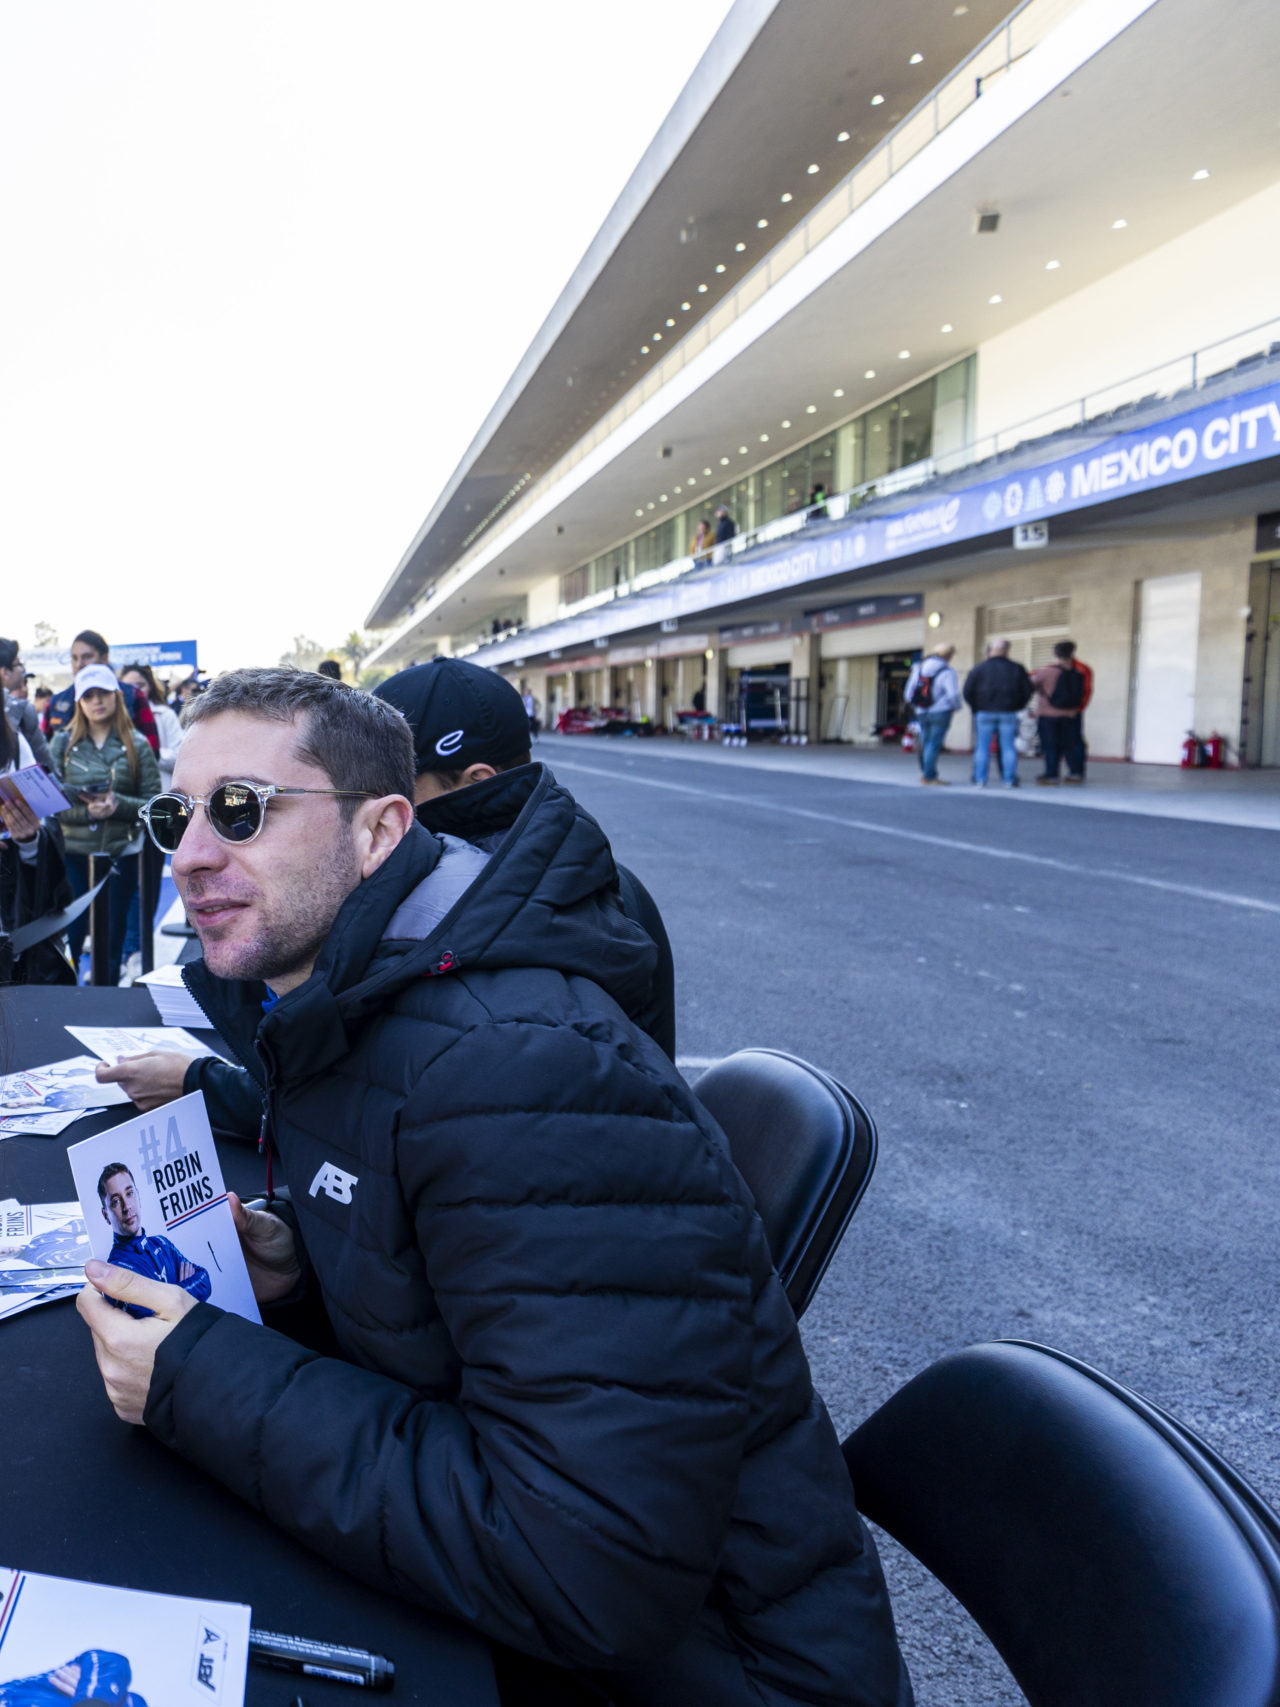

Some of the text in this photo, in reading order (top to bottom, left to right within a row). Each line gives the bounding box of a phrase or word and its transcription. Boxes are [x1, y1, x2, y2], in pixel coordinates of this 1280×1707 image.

[1071, 428, 1197, 498] MEXICO
[1021, 526, 1046, 541] 15
[138, 1116, 188, 1185] #4
[152, 1151, 203, 1193] ROBIN
[159, 1176, 214, 1222] FRIJNS
[6, 1211, 25, 1237] FRIJNS
[197, 1653, 216, 1693] ABT
